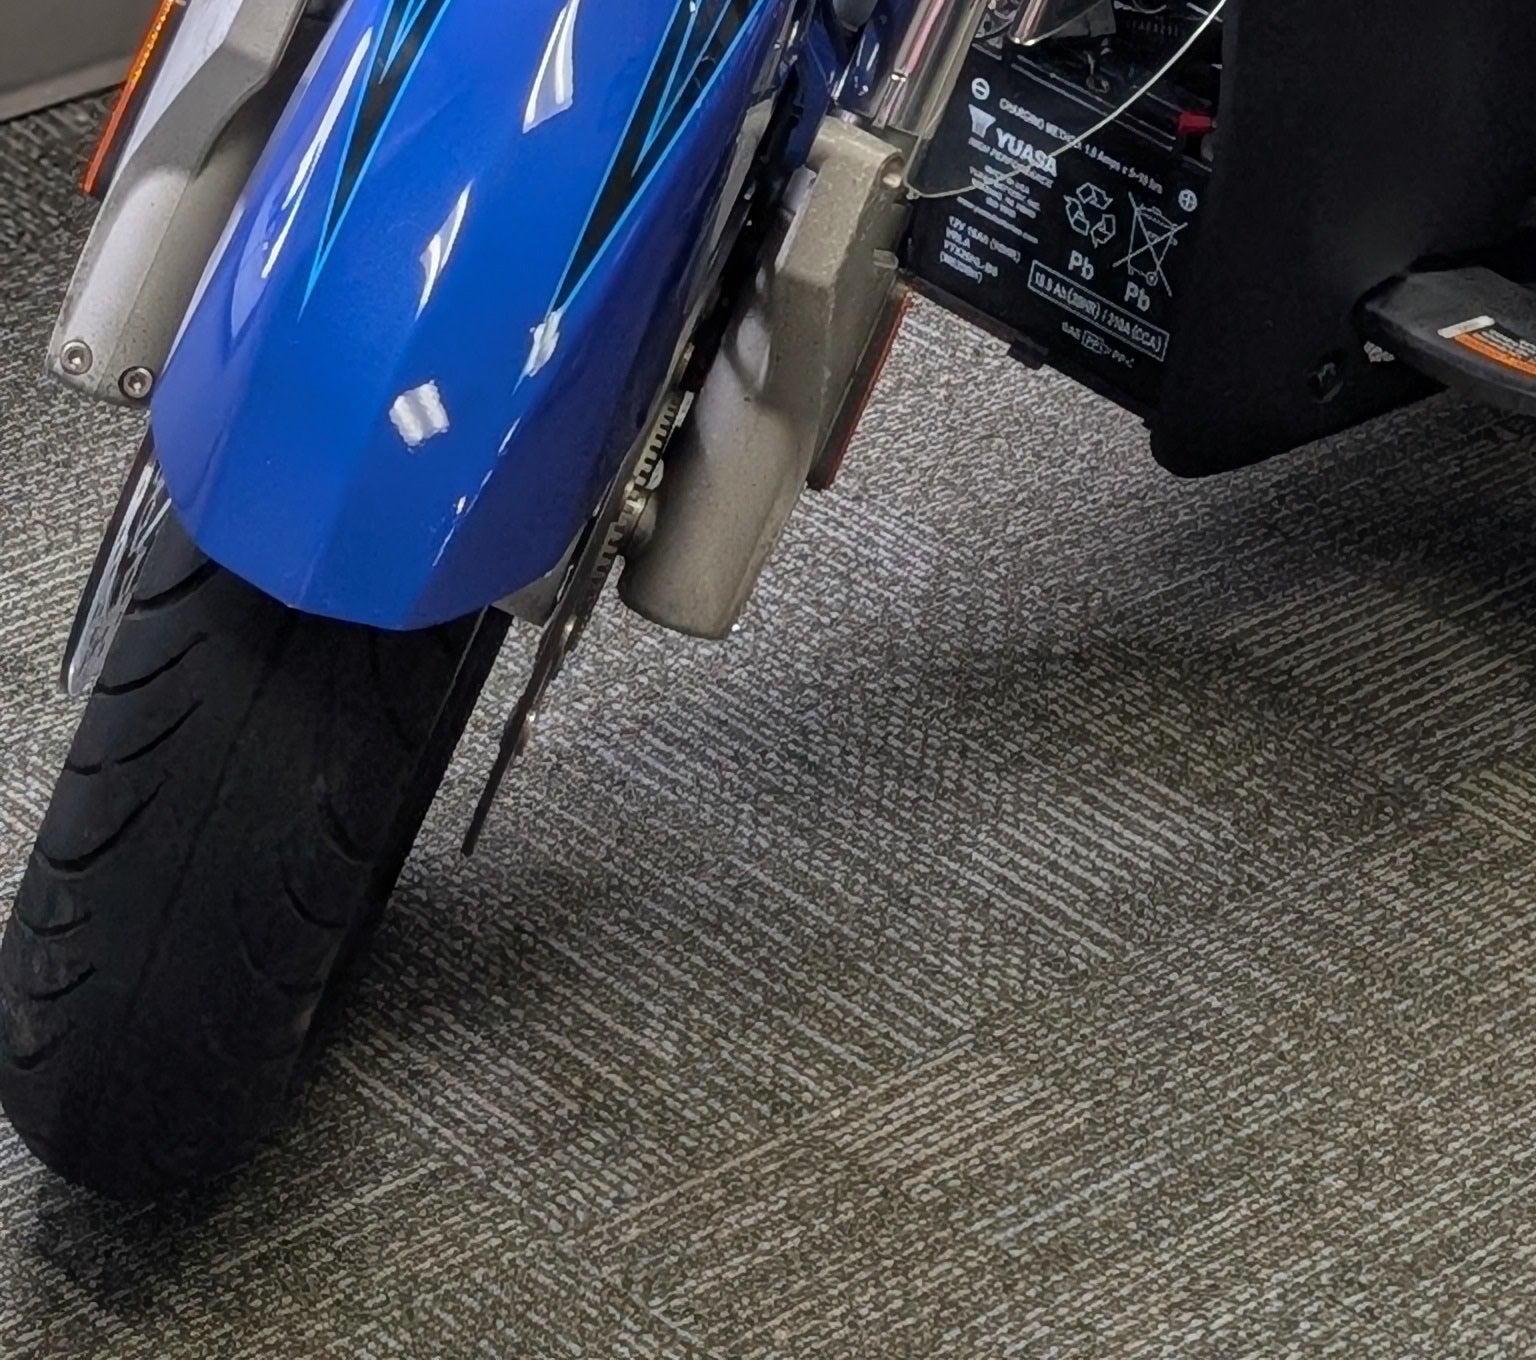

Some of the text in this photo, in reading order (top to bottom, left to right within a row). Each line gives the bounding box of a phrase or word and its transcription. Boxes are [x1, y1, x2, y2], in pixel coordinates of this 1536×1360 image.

[996, 128, 1058, 178] YUASA
[1068, 249, 1095, 280] Pb
[1124, 281, 1150, 312] Pb
